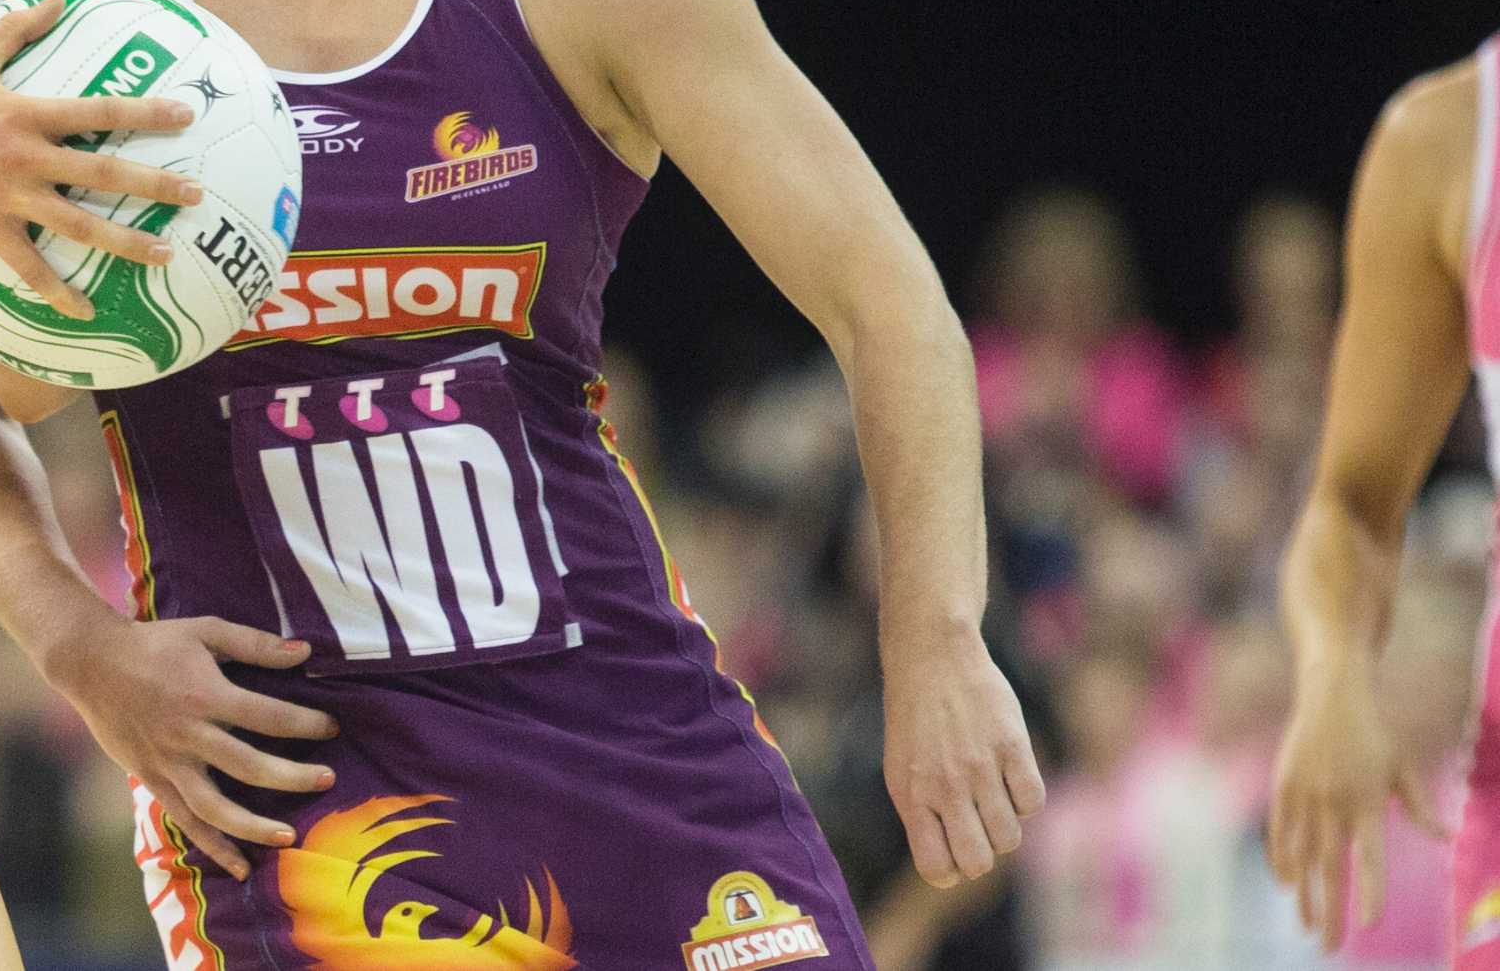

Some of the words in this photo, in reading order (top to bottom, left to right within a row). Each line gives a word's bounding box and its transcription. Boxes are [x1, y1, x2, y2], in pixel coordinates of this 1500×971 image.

[300, 137, 365, 155] ODY
[409, 148, 534, 199] FIREBIRDS
[245, 266, 520, 332] SSION
[258, 423, 541, 660] WD
